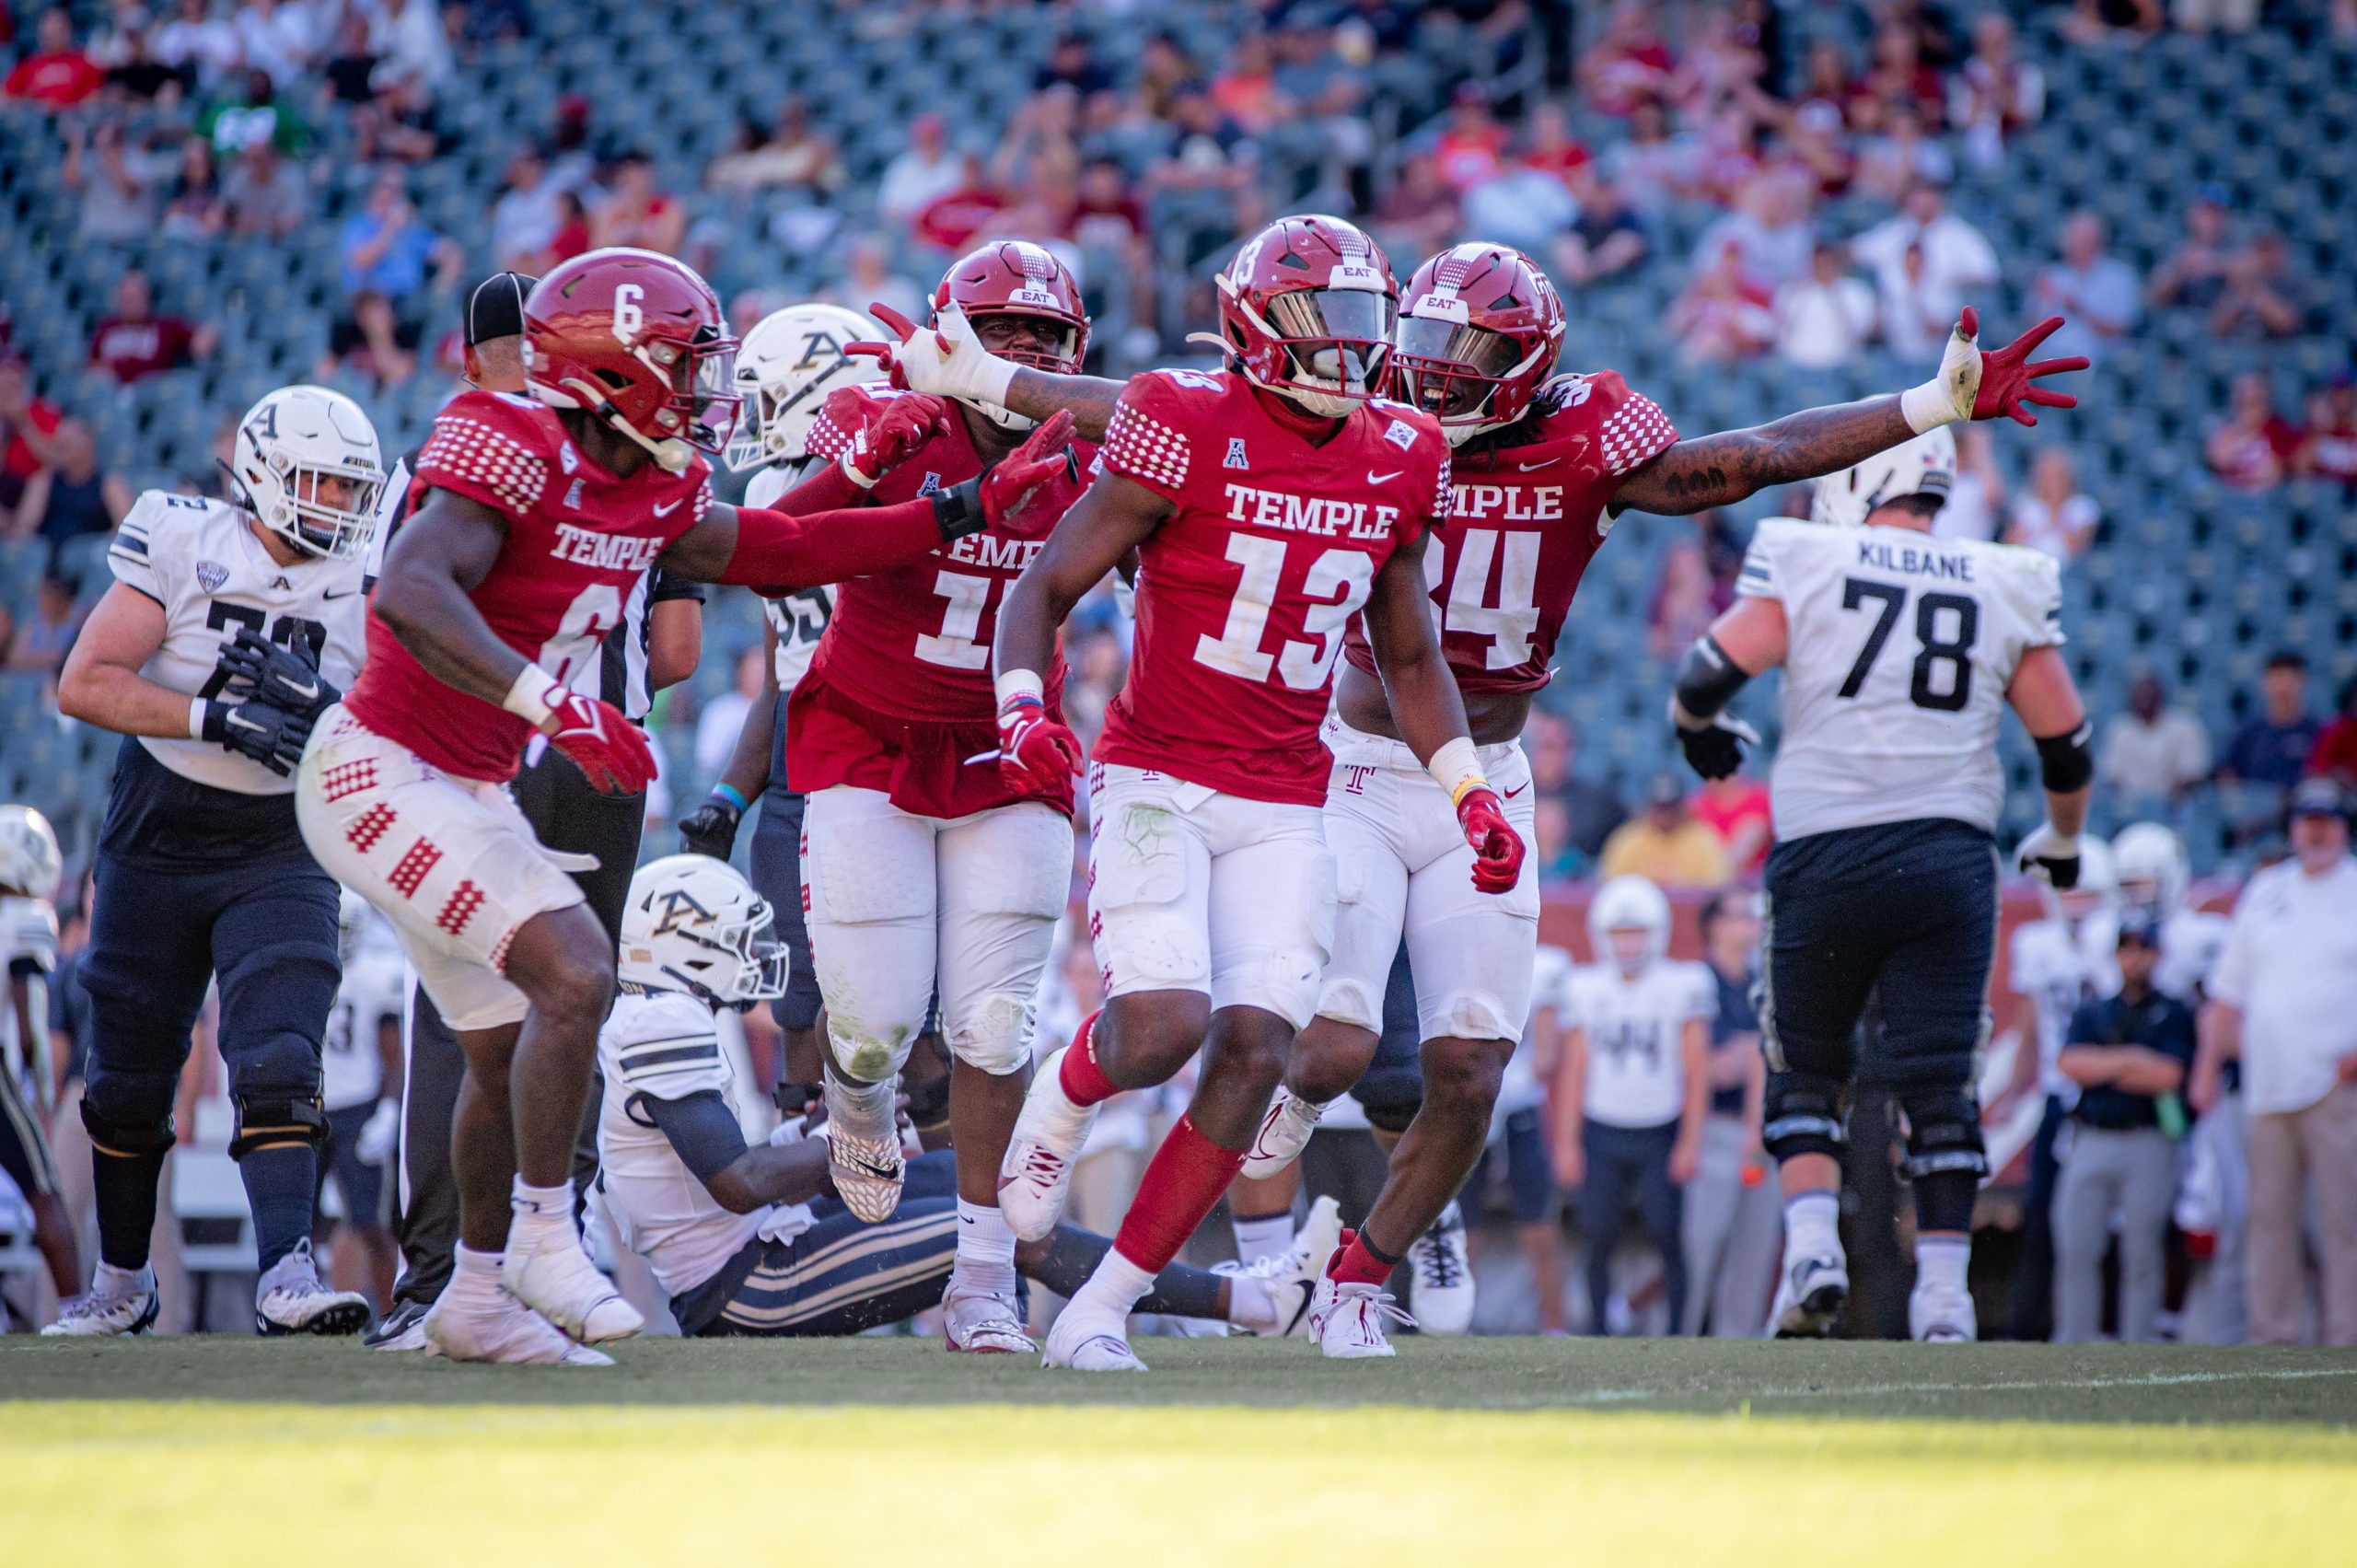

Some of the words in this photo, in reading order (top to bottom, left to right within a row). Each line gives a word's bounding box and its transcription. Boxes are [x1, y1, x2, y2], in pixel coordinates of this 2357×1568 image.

[1021, 291, 1050, 303] EAT
[1343, 267, 1371, 278] EAT
[612, 284, 644, 333] 6
[1426, 296, 1457, 310] EAT
[791, 332, 858, 371] A
[1225, 482, 1399, 540] TEMPLE
[550, 522, 666, 571] TEMPLE
[1858, 540, 1975, 582] KILBANE
[538, 583, 621, 688] 6
[914, 569, 1018, 670] 1
[1193, 531, 1375, 691] 13
[1837, 575, 1980, 713] 78
[651, 889, 719, 938] A
